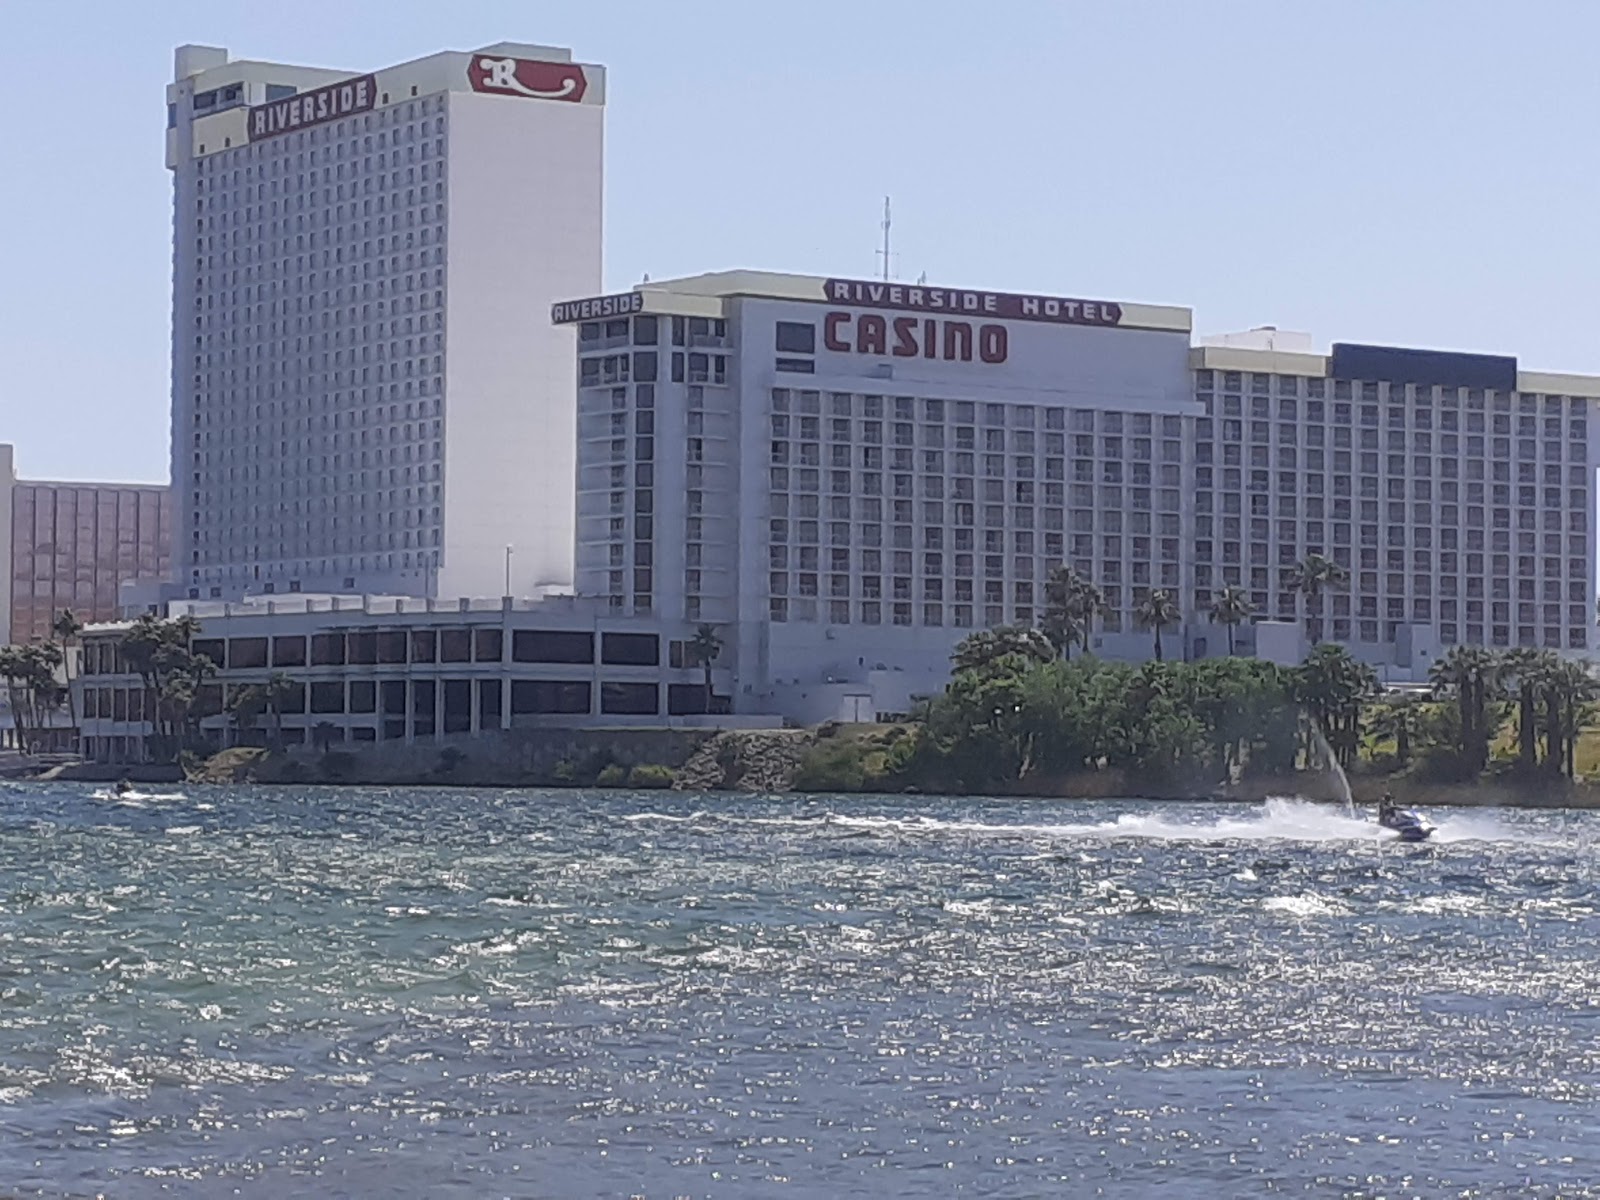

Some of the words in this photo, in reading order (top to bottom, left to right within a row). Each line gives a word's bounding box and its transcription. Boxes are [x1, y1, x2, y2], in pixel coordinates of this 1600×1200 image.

[254, 81, 369, 135] RIVERSIDE
[554, 294, 641, 321] RIVERSIDE
[833, 283, 998, 312] RIVERSIDE
[1022, 298, 1113, 321] HOTEL
[824, 312, 1008, 364] CASINO
